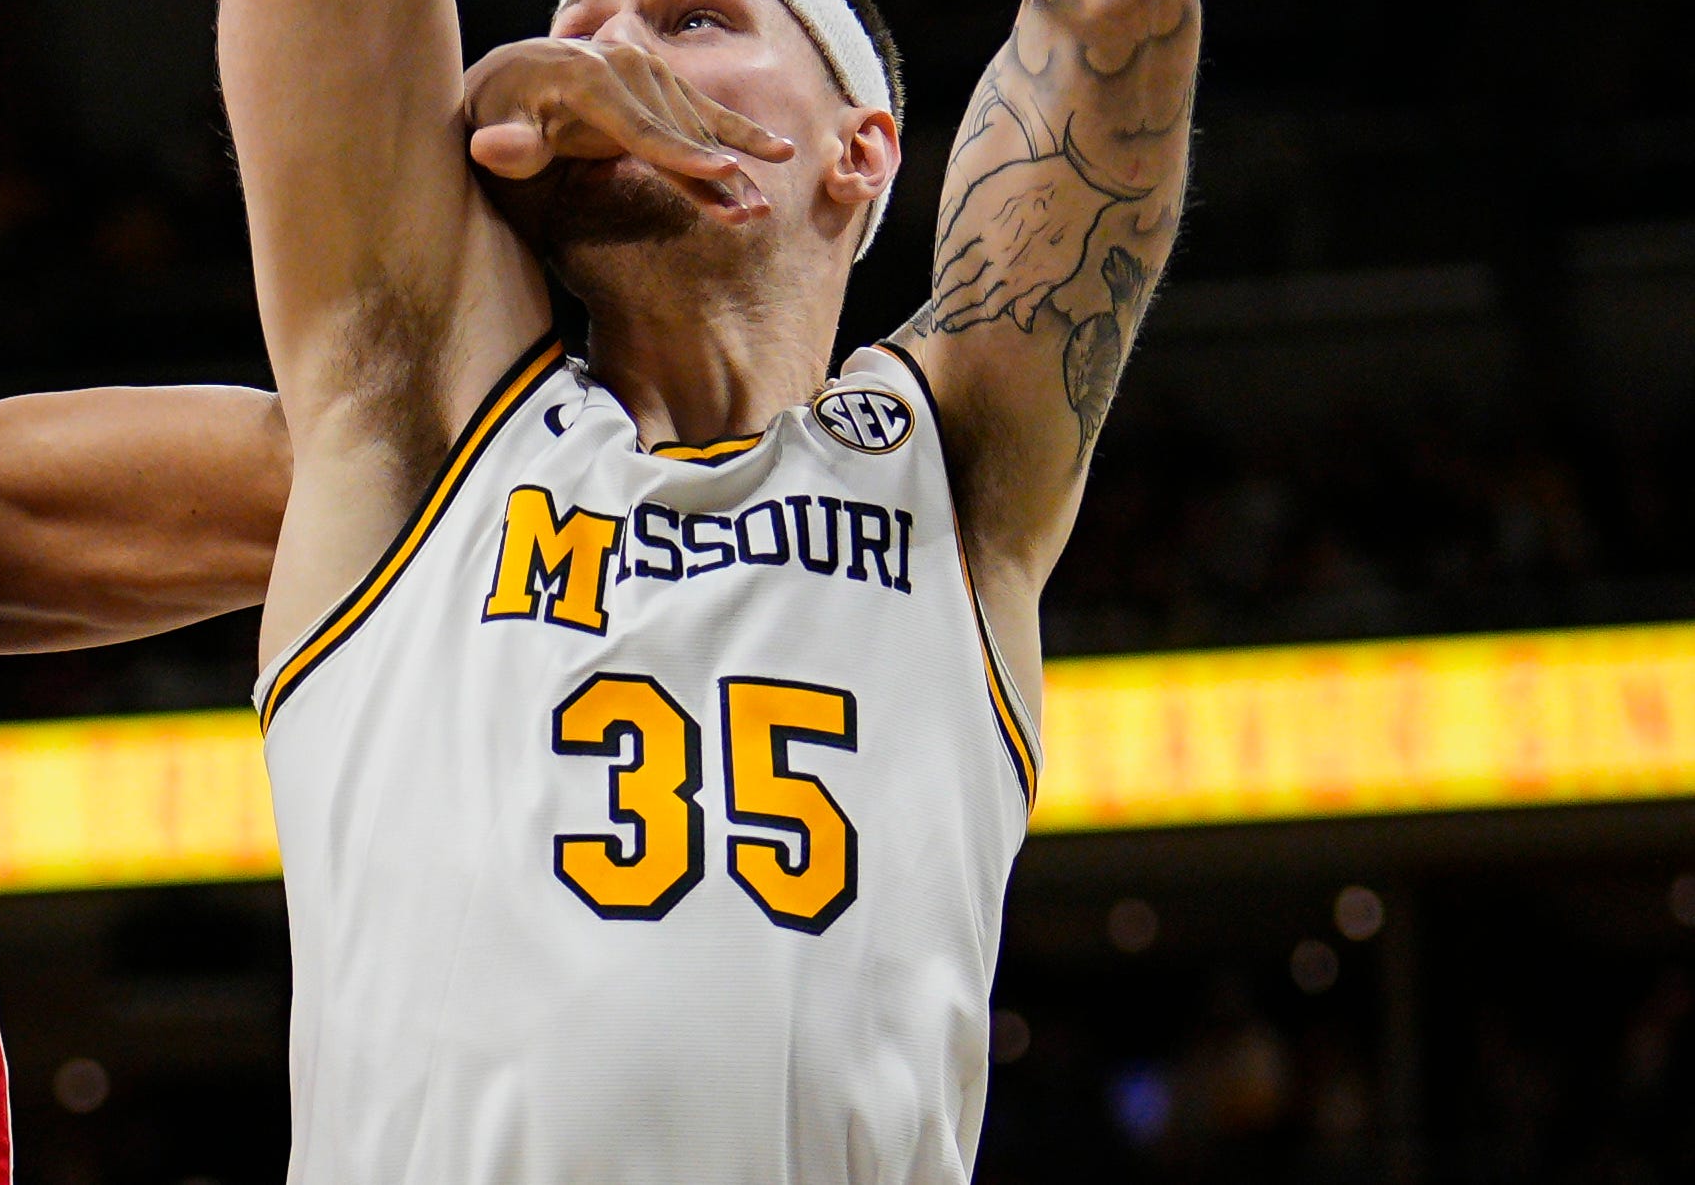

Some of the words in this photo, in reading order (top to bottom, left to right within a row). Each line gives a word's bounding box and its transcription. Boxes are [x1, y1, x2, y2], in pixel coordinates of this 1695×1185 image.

[819, 392, 908, 449] SEC
[481, 484, 914, 637] MISSOURI
[552, 671, 858, 935] 35
